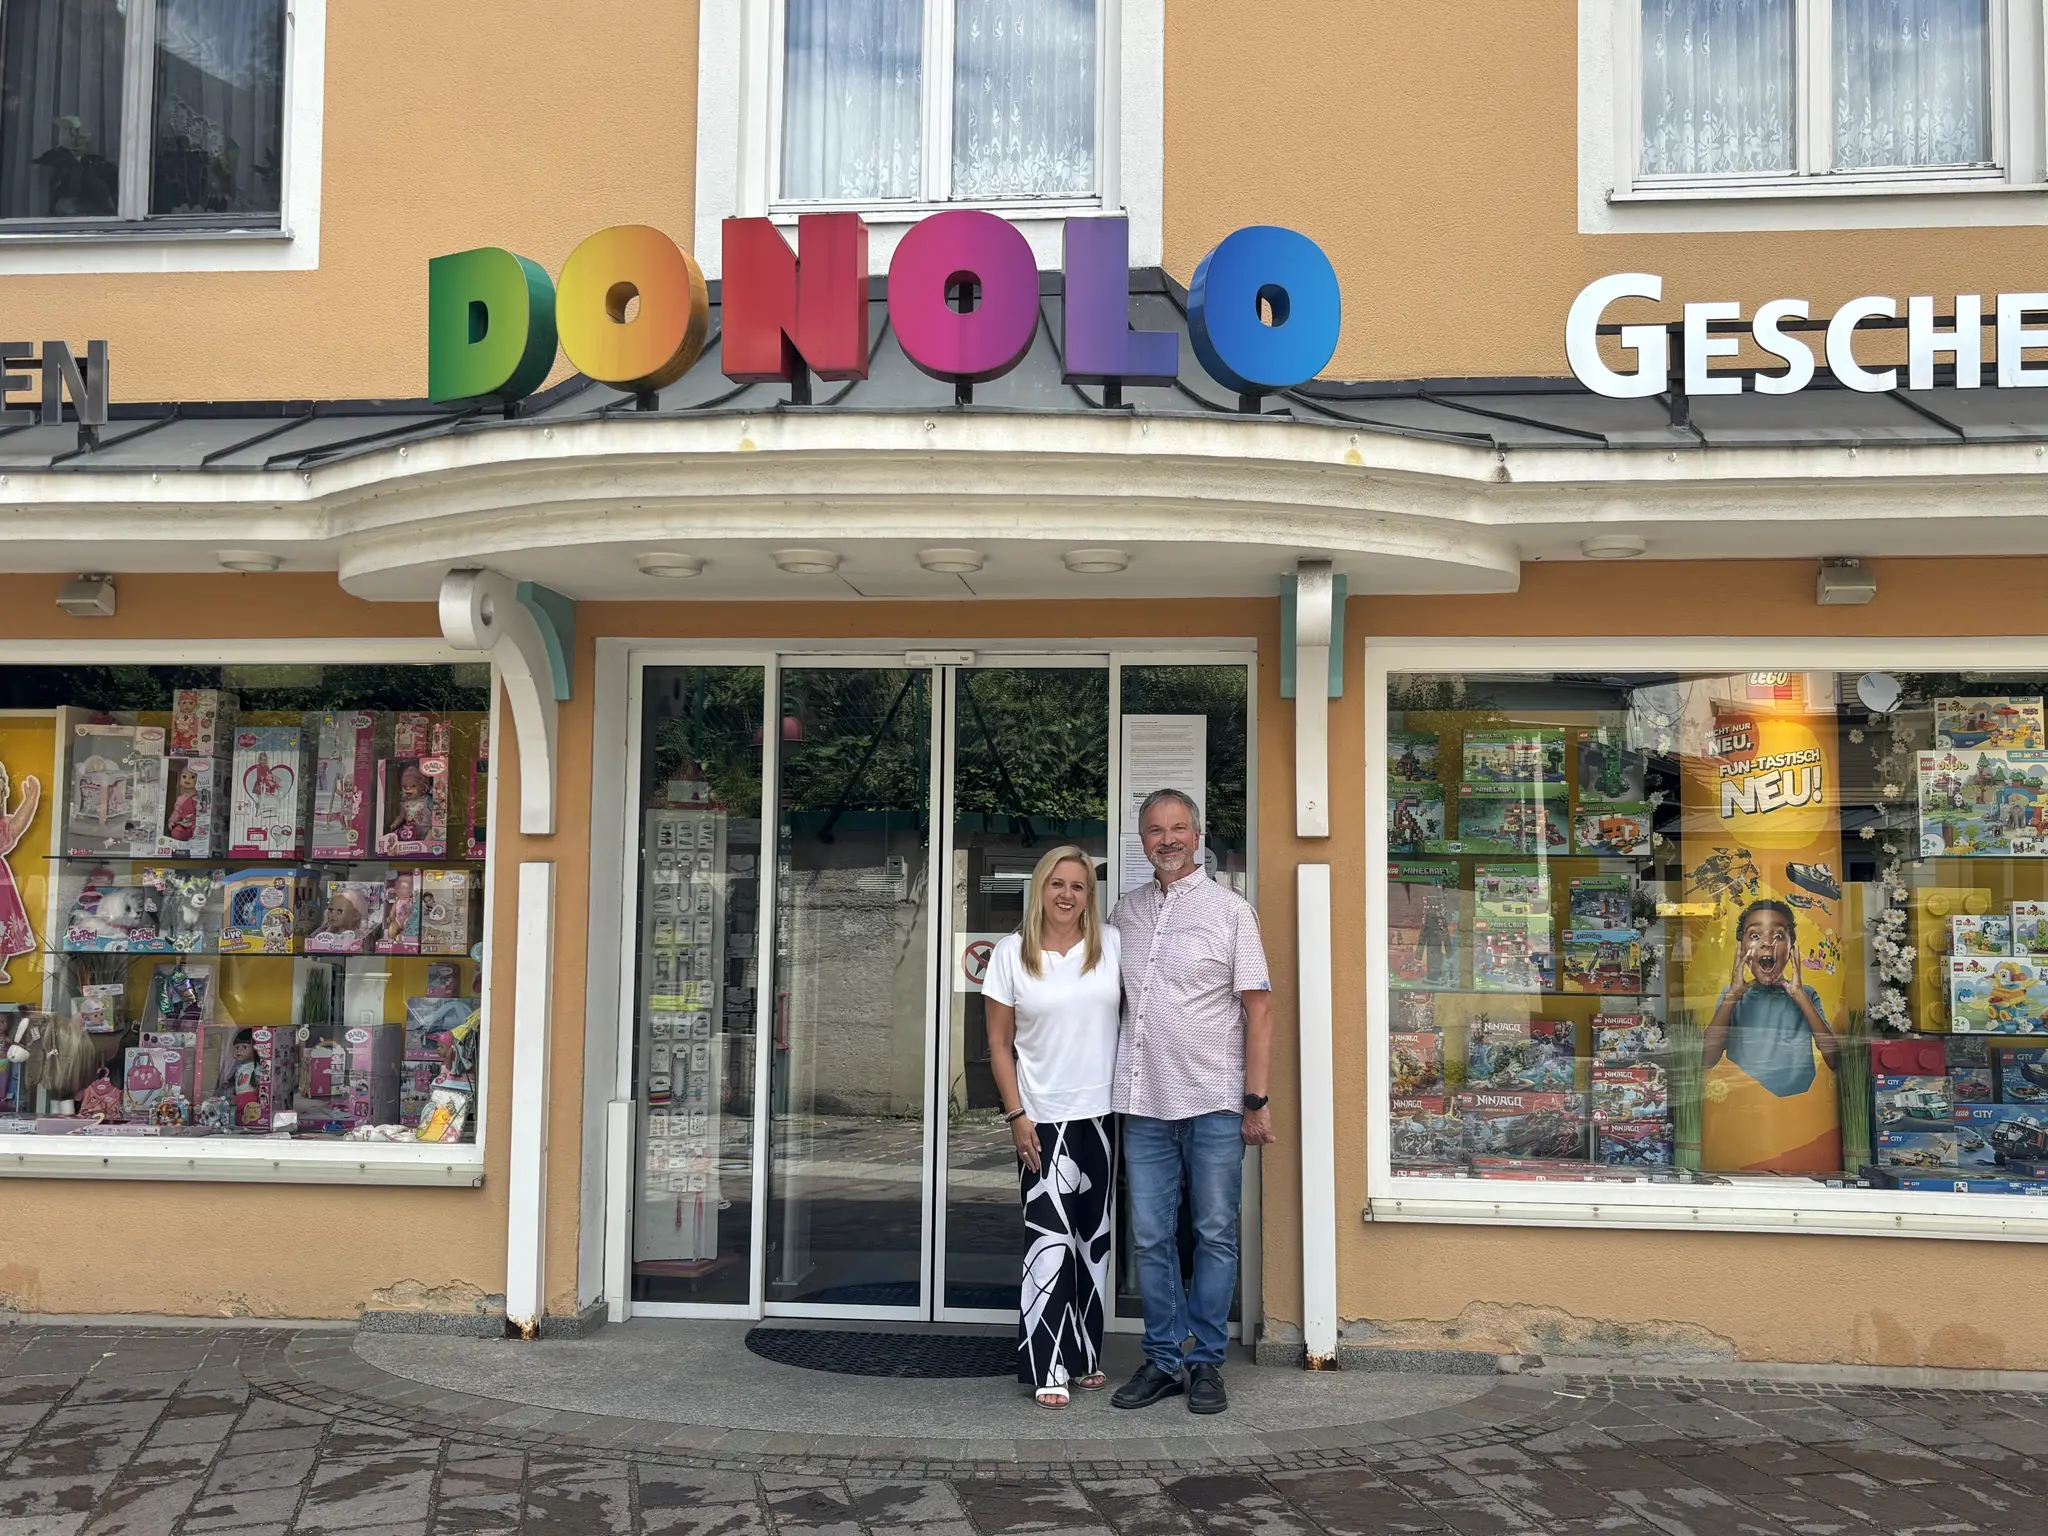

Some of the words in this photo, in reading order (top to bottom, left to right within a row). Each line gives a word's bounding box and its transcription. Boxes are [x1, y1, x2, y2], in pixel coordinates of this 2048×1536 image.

[429, 210, 1341, 401] DONOLO
[1705, 726, 1730, 739] NICHT
[1732, 722, 1752, 733] NUR
[1708, 734, 1754, 756] NEU,
[1719, 747, 1821, 778] FUN-TASTISCH
[1937, 760, 1969, 772] duplo
[1475, 786, 1516, 794] MINECRAFT
[1721, 766, 1823, 819] NEU!
[1921, 839, 1938, 849] 2+
[1403, 867, 1450, 875] MINECRAFT
[1483, 1022, 1522, 1033] NINJAGO
[1954, 1018, 1966, 1027] 2+
[2016, 1053, 2033, 1061] CITY
[1392, 1099, 1424, 1110] NINJAGO
[1475, 1094, 1525, 1109] NINJAGO
[1593, 1112, 1606, 1121] 4+
[1973, 1109, 1993, 1119] CITY
